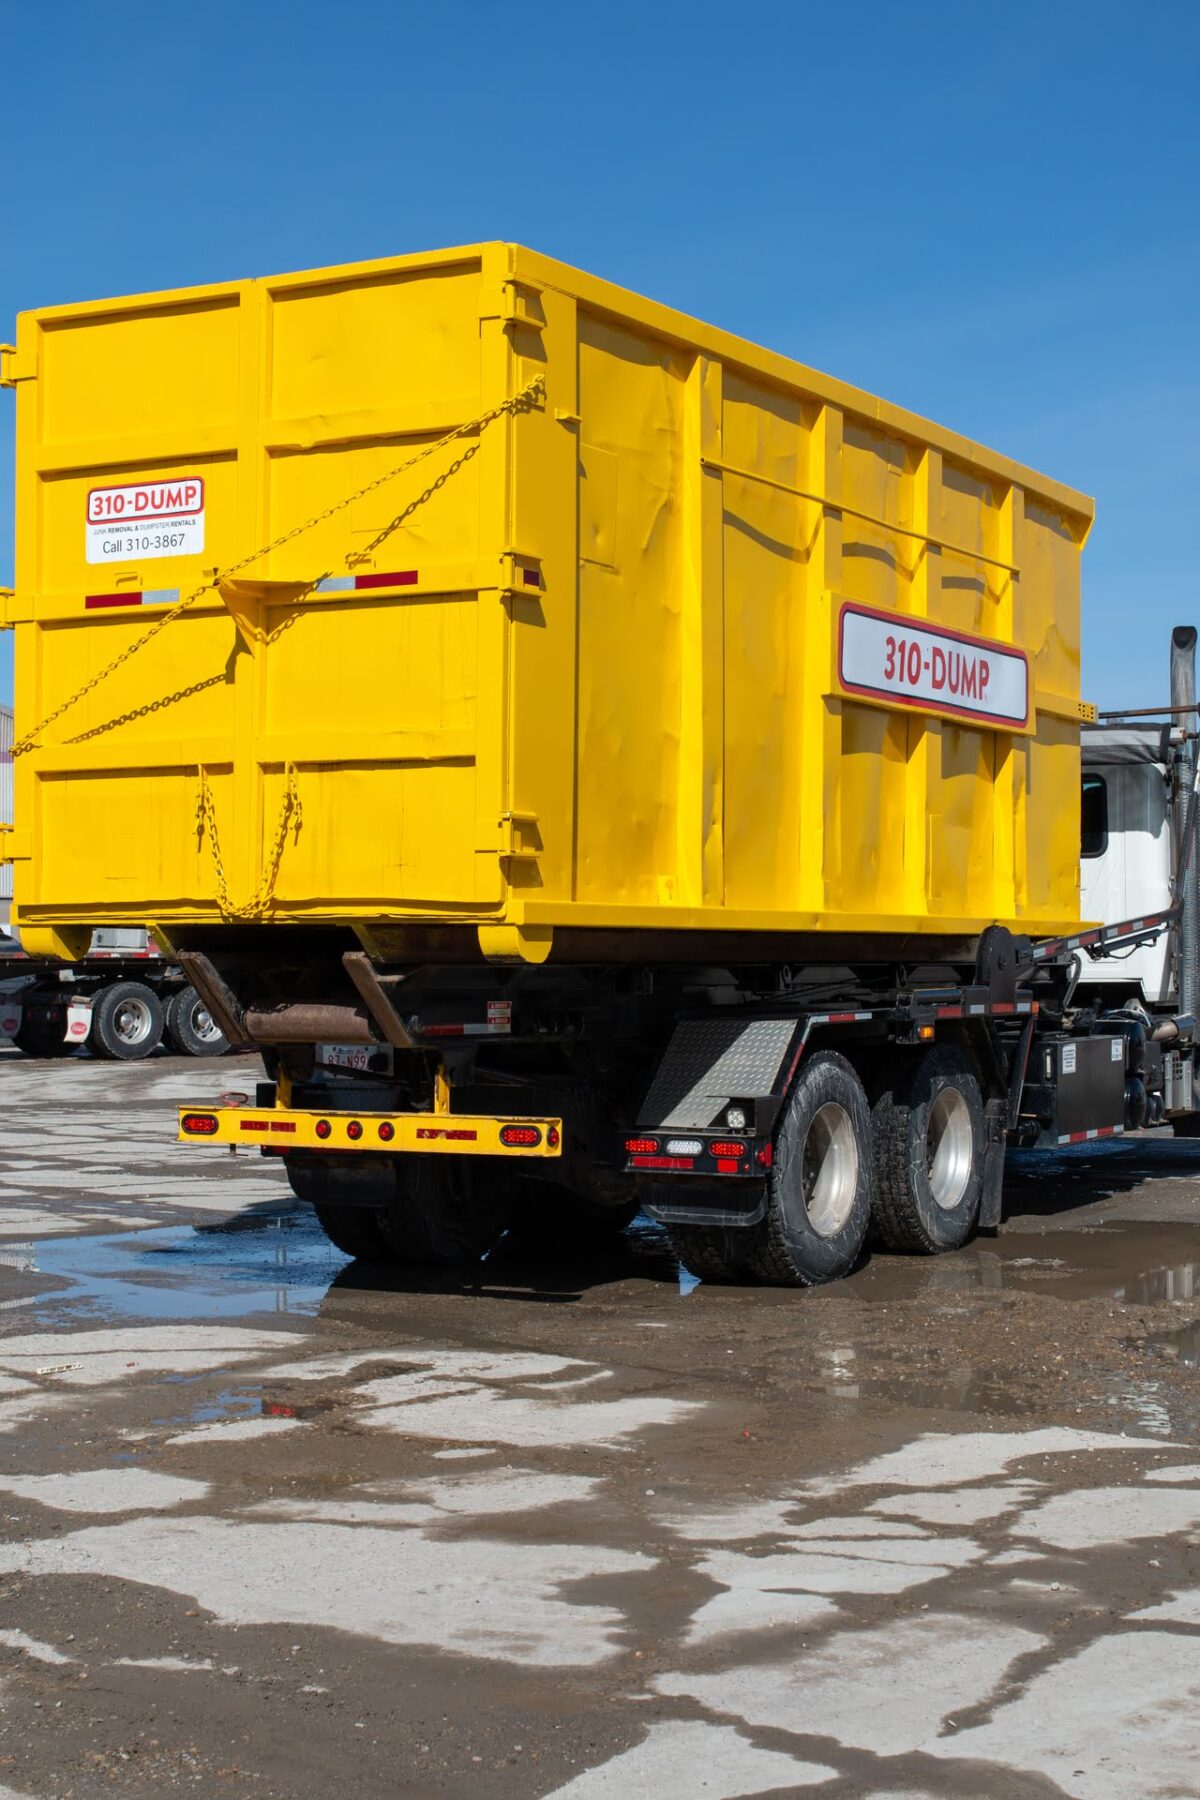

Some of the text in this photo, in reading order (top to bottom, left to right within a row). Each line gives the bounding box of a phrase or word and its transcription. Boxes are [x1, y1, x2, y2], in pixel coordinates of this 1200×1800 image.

[93, 485, 197, 516] 310-DUMP
[108, 525, 133, 534] REMOVAL
[140, 522, 169, 531] DUMPSTER
[170, 519, 196, 527] RENTALS
[102, 533, 185, 554] Call 310-3867
[884, 635, 990, 701] 310-DUMP
